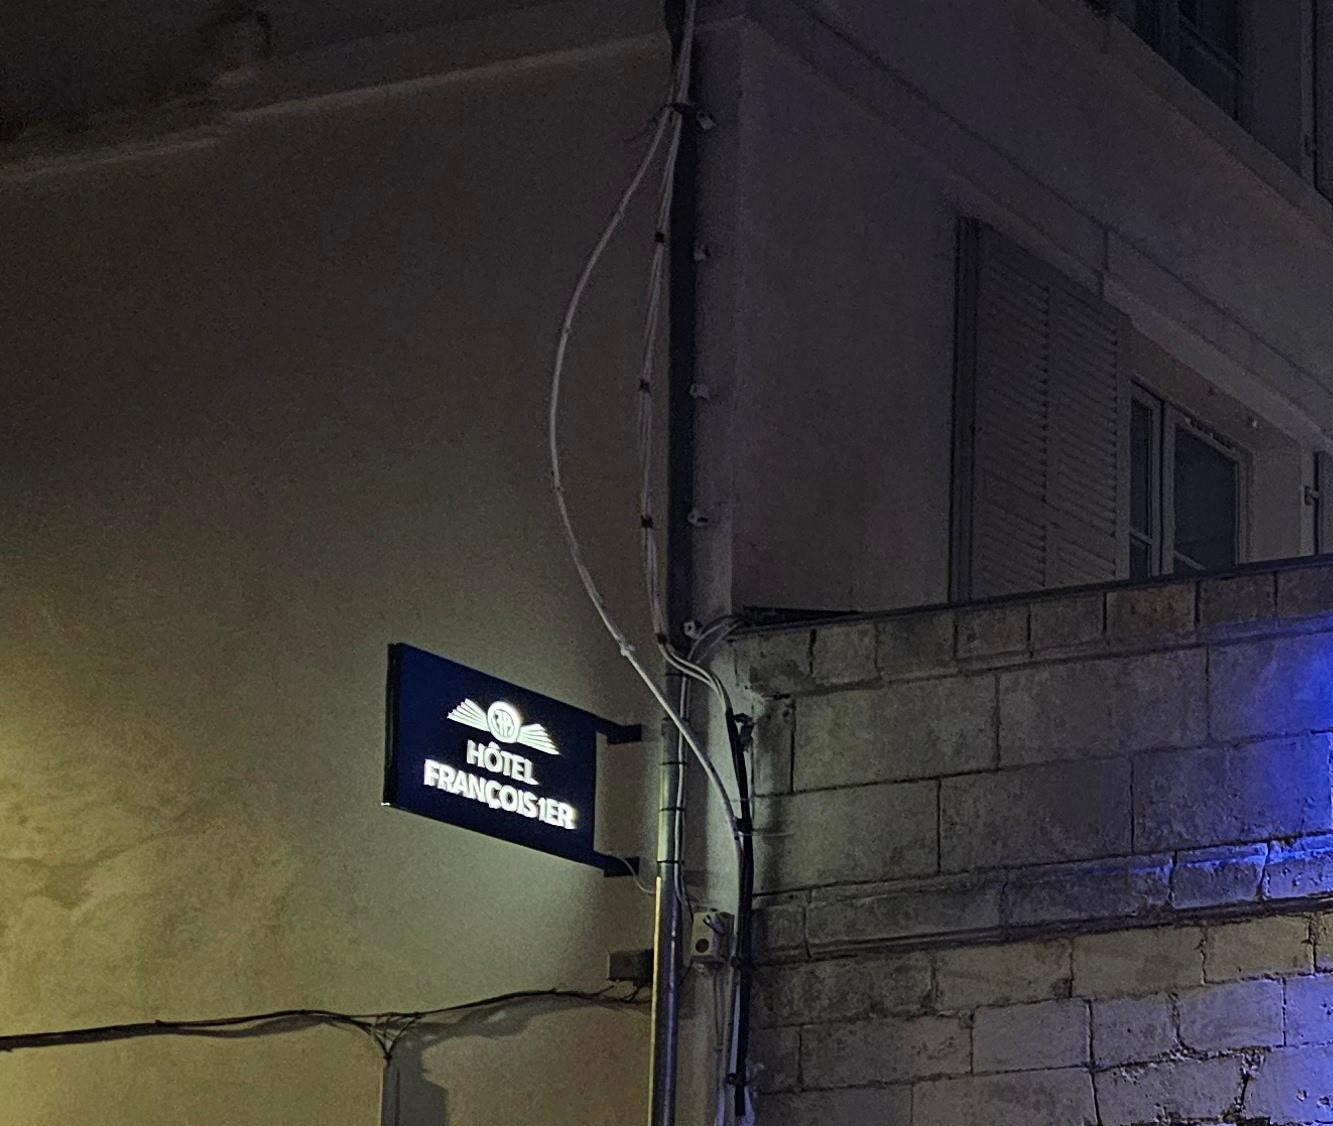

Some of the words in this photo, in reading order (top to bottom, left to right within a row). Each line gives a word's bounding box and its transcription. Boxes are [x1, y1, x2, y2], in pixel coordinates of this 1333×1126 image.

[466, 739, 540, 786] HÔTEL
[423, 758, 537, 819] FRANÇOIS
[537, 796, 580, 830] 1ER
